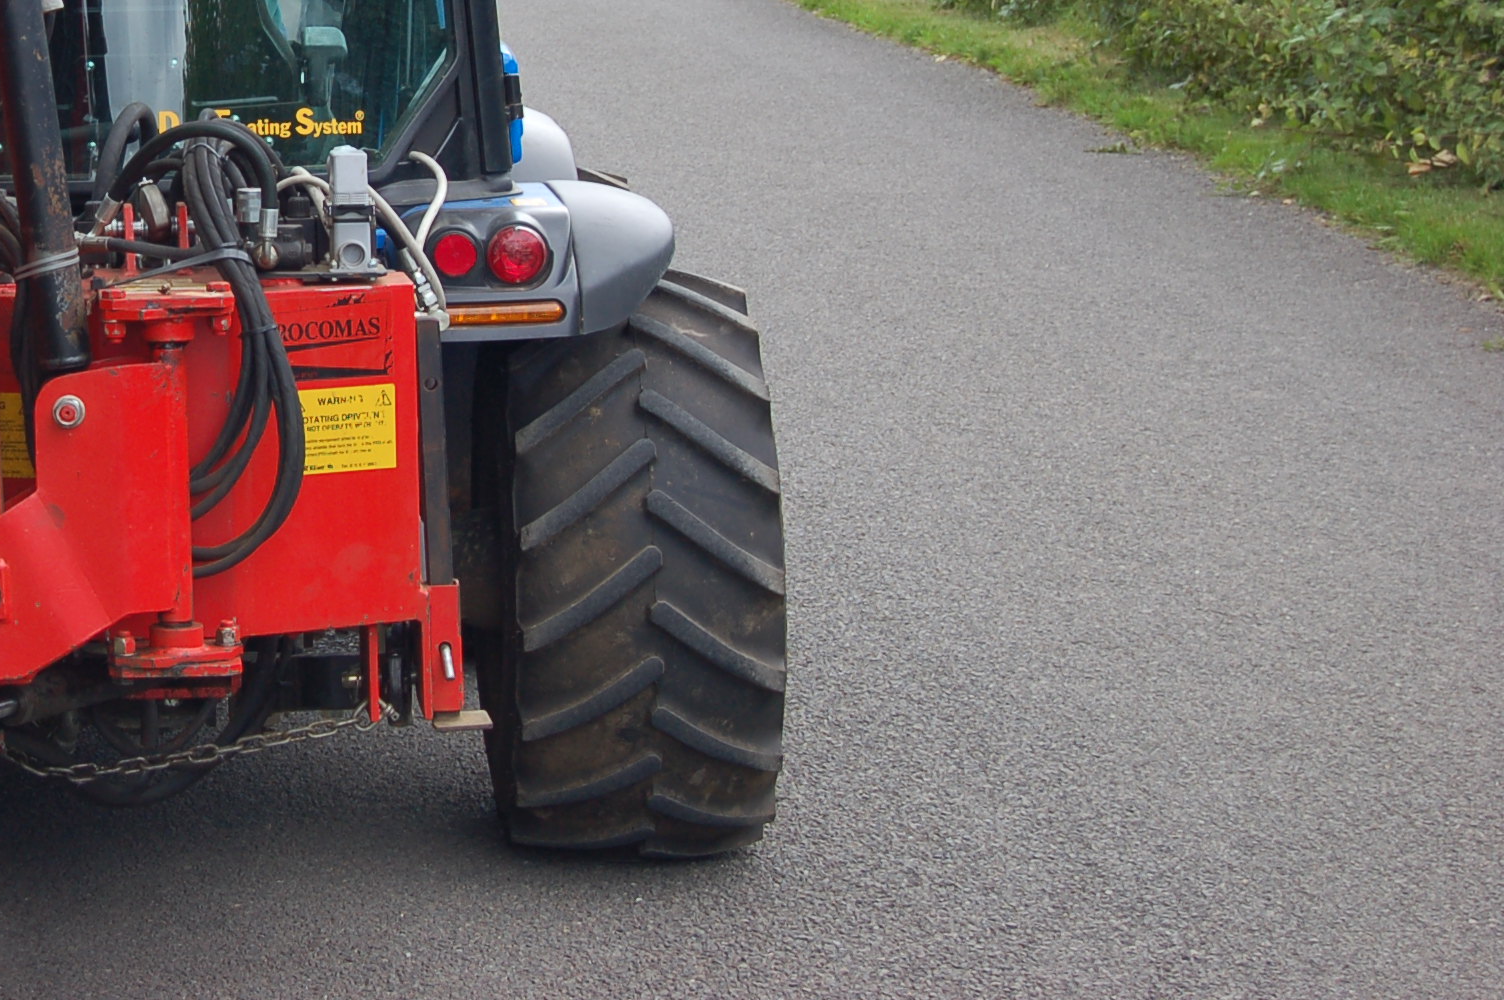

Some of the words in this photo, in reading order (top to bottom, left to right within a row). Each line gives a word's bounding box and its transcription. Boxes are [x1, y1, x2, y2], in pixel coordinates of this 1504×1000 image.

[277, 317, 381, 342] ROCOMAS
[317, 395, 364, 406] WARN
[303, 414, 339, 424] OTATING
[341, 411, 385, 422] DRIVN
